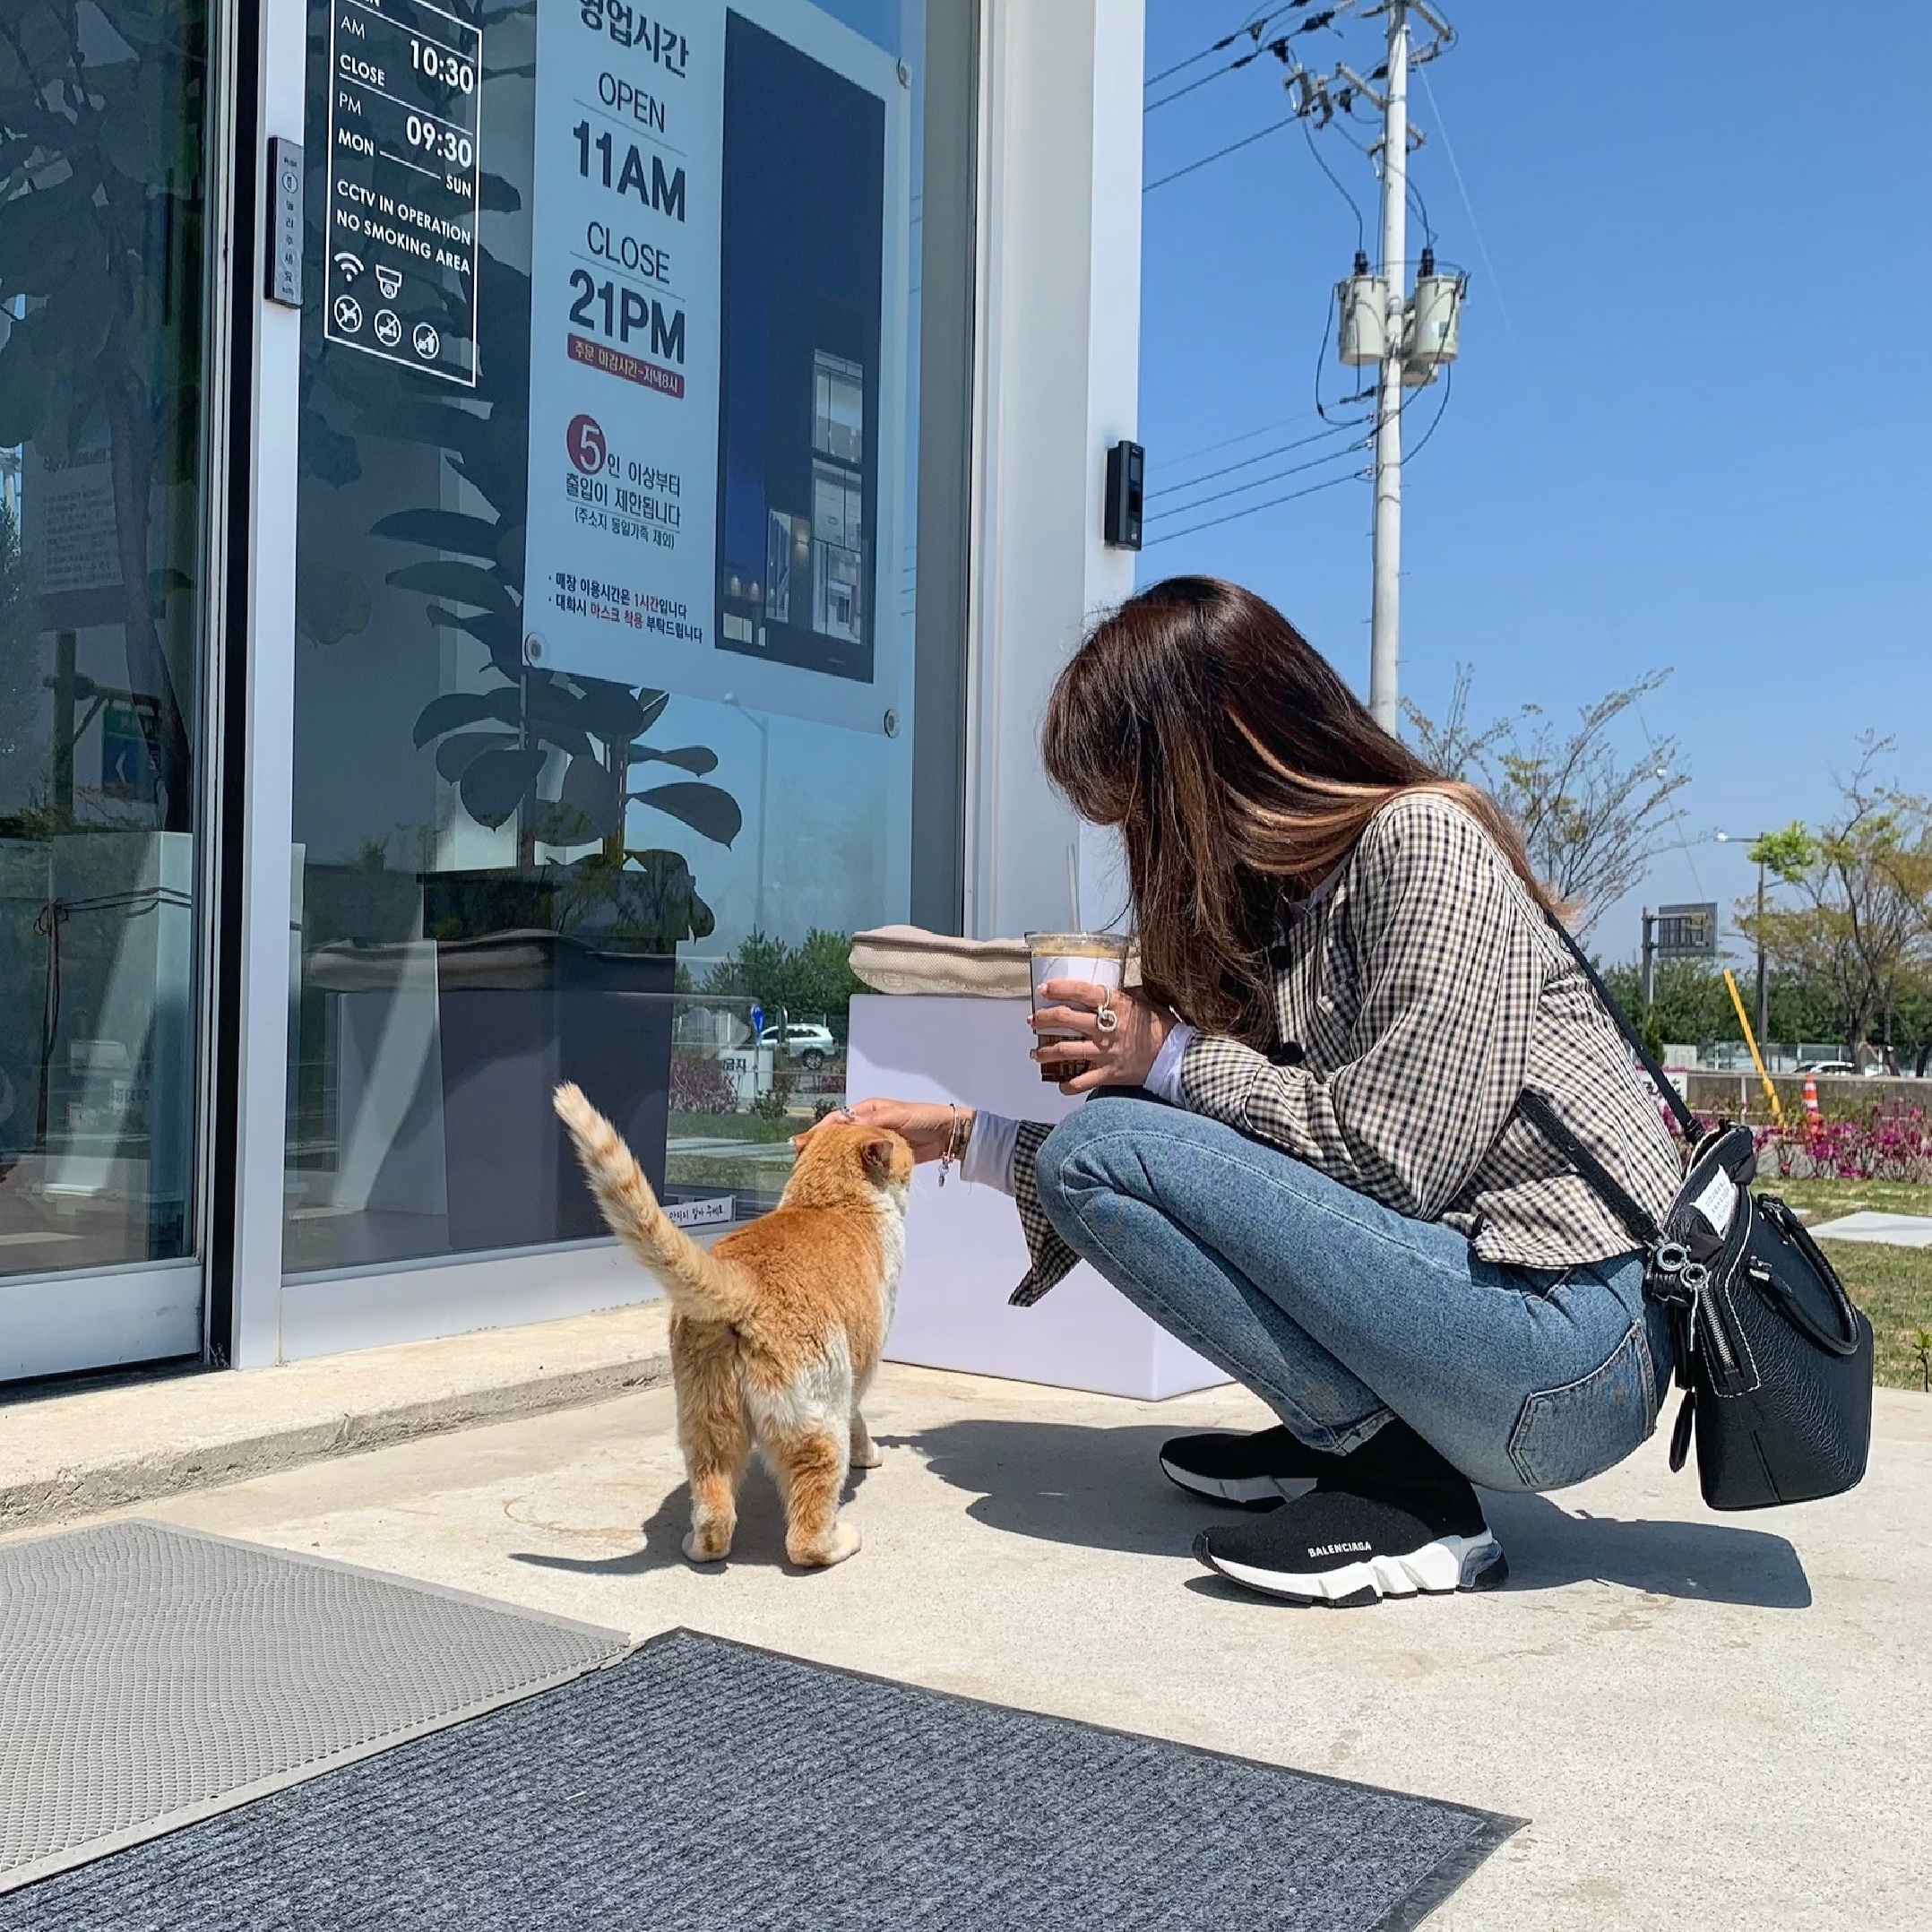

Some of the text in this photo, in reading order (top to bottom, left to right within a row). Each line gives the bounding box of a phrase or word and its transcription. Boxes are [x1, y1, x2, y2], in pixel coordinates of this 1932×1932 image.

[340, 54, 385, 86] CLOSE
[341, 15, 473, 94] AM 10:30
[580, 0, 690, 79] 영업시간
[339, 91, 472, 168] PM 09:30
[599, 72, 665, 134] OPEN
[338, 128, 471, 198] MON SUN
[573, 119, 686, 223] 11AM
[336, 210, 470, 275] NO SMOKING AREA
[337, 181, 471, 246] CCTV IN OPERATION
[587, 221, 670, 284] CLOSE
[569, 269, 685, 365] 21PM
[575, 341, 594, 362] 주문
[566, 472, 681, 528] 출입이 제한됩니다
[628, 461, 681, 497] 이상부터
[556, 593, 703, 643] 대화시 마스크 착용 부탁드립니다
[580, 578, 630, 607] 이용시간은
[634, 592, 687, 620] 1시간입니다
[1307, 1541, 1372, 1557] BALENCIAGA
